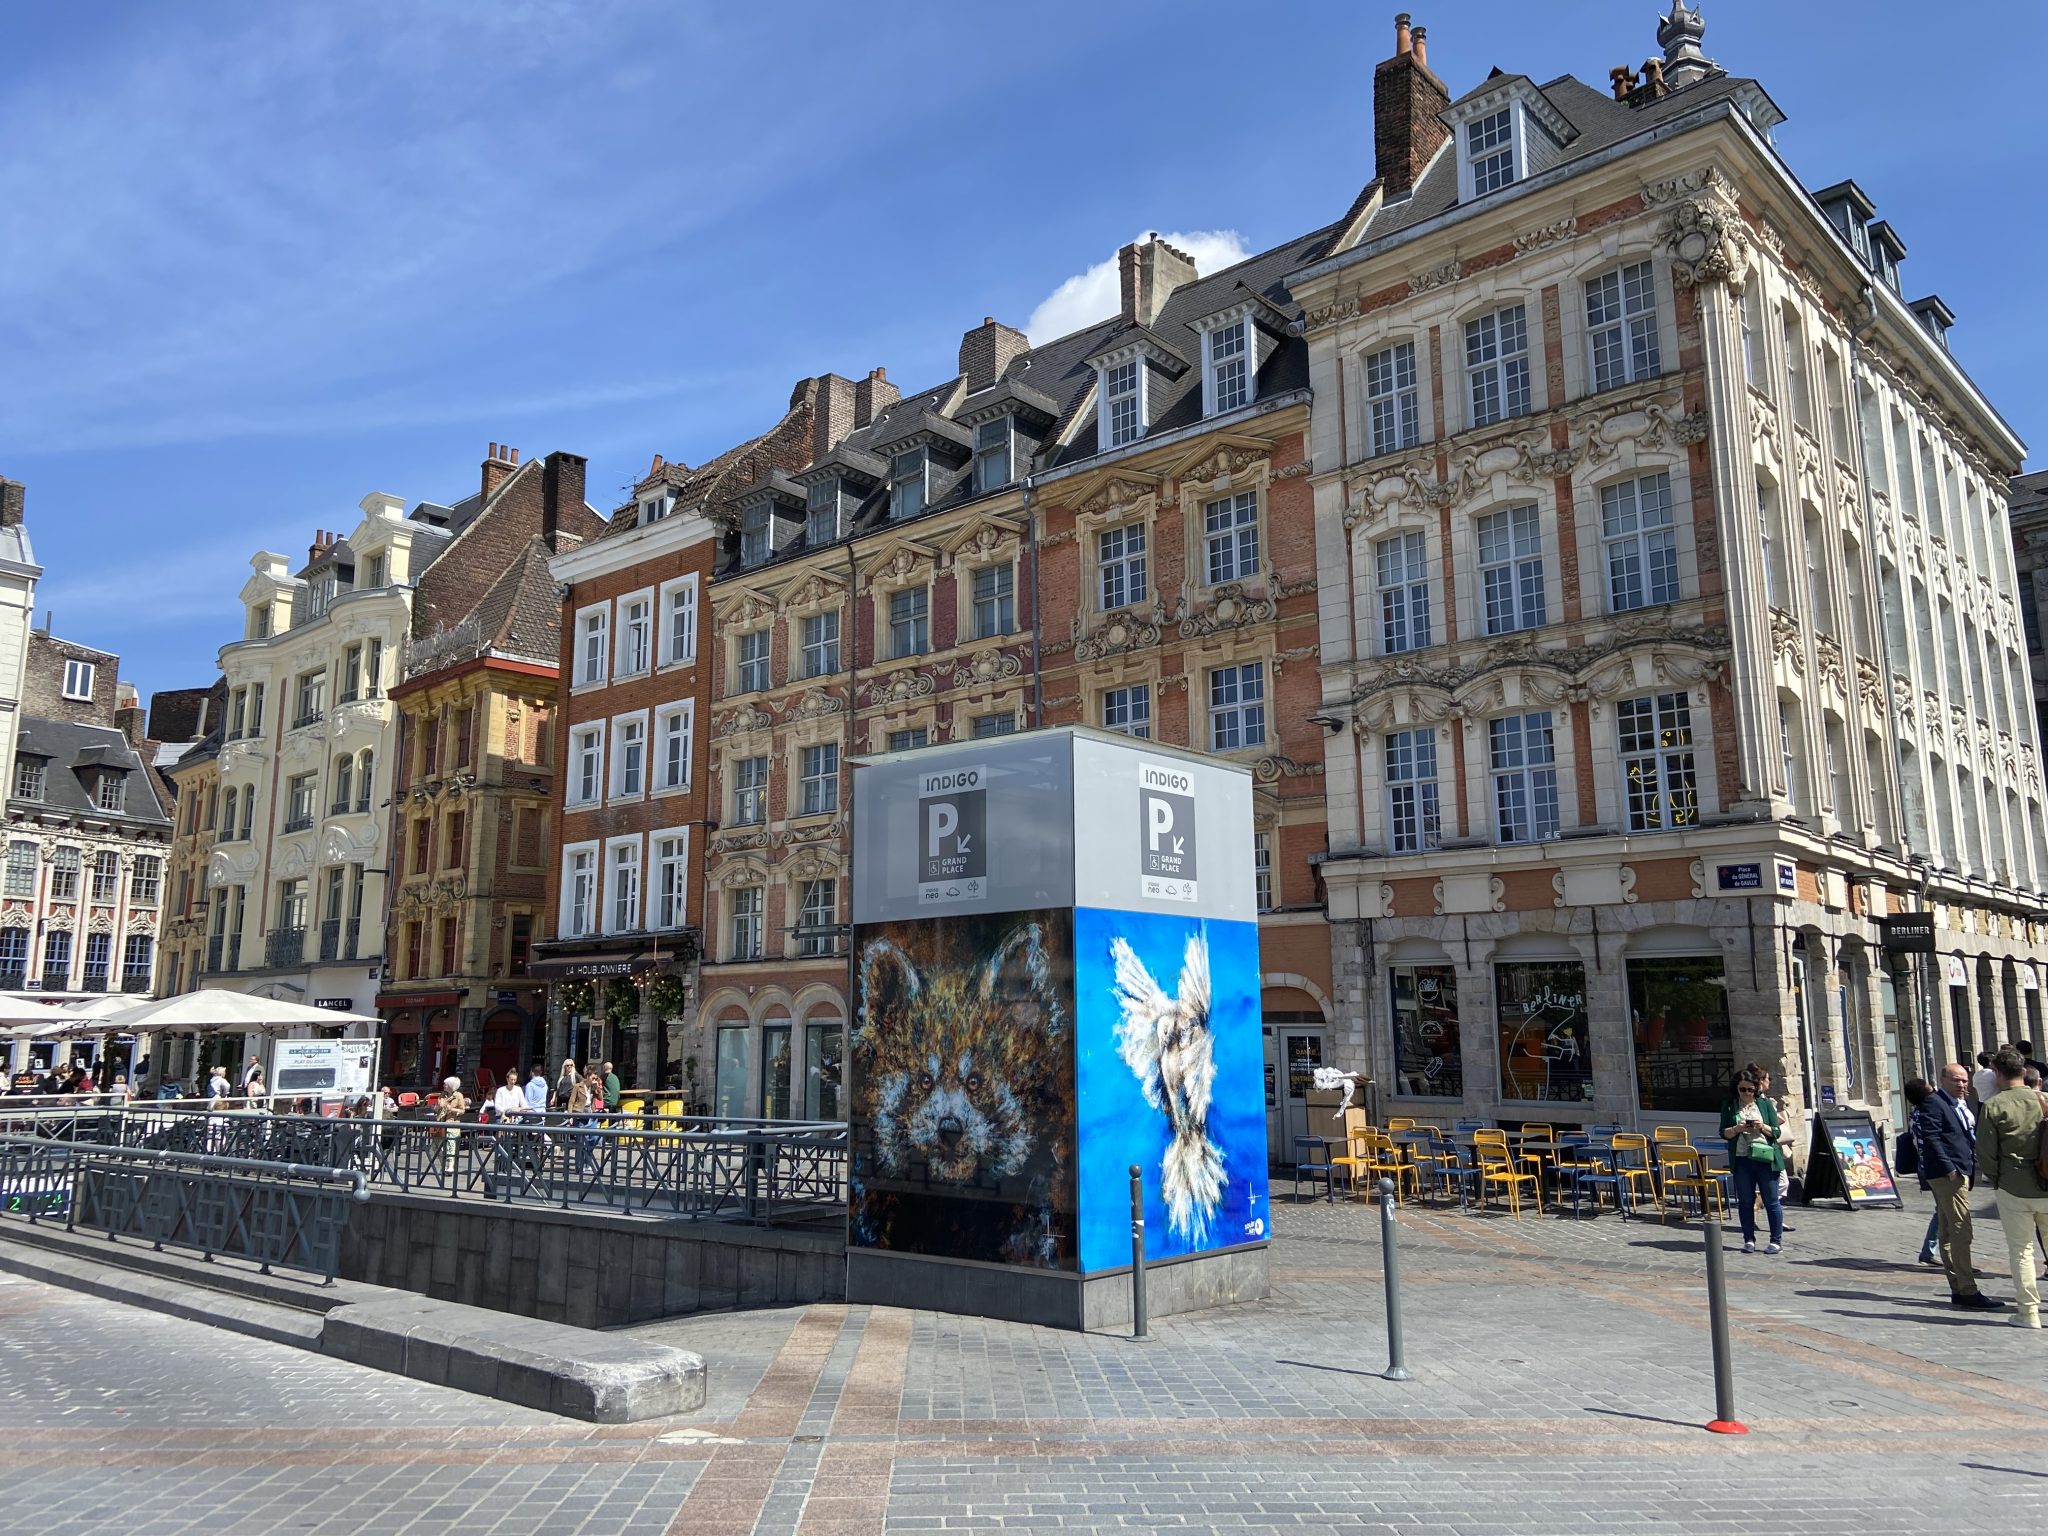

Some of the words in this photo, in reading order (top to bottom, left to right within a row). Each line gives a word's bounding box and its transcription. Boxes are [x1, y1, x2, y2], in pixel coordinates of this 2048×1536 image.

[926, 771, 978, 792] INDIGO
[1145, 769, 1188, 792] INDIGO
[1149, 797, 1174, 851] P
[929, 803, 959, 857] P
[942, 857, 967, 866] GRAND
[1161, 855, 1182, 865] GRAND
[942, 864, 964, 874] PLACE
[1161, 863, 1180, 873] PLACE
[1148, 886, 1160, 894] neo
[926, 892, 939, 900] neo
[1890, 926, 1930, 935] BERLINER
[565, 966, 574, 976] LA
